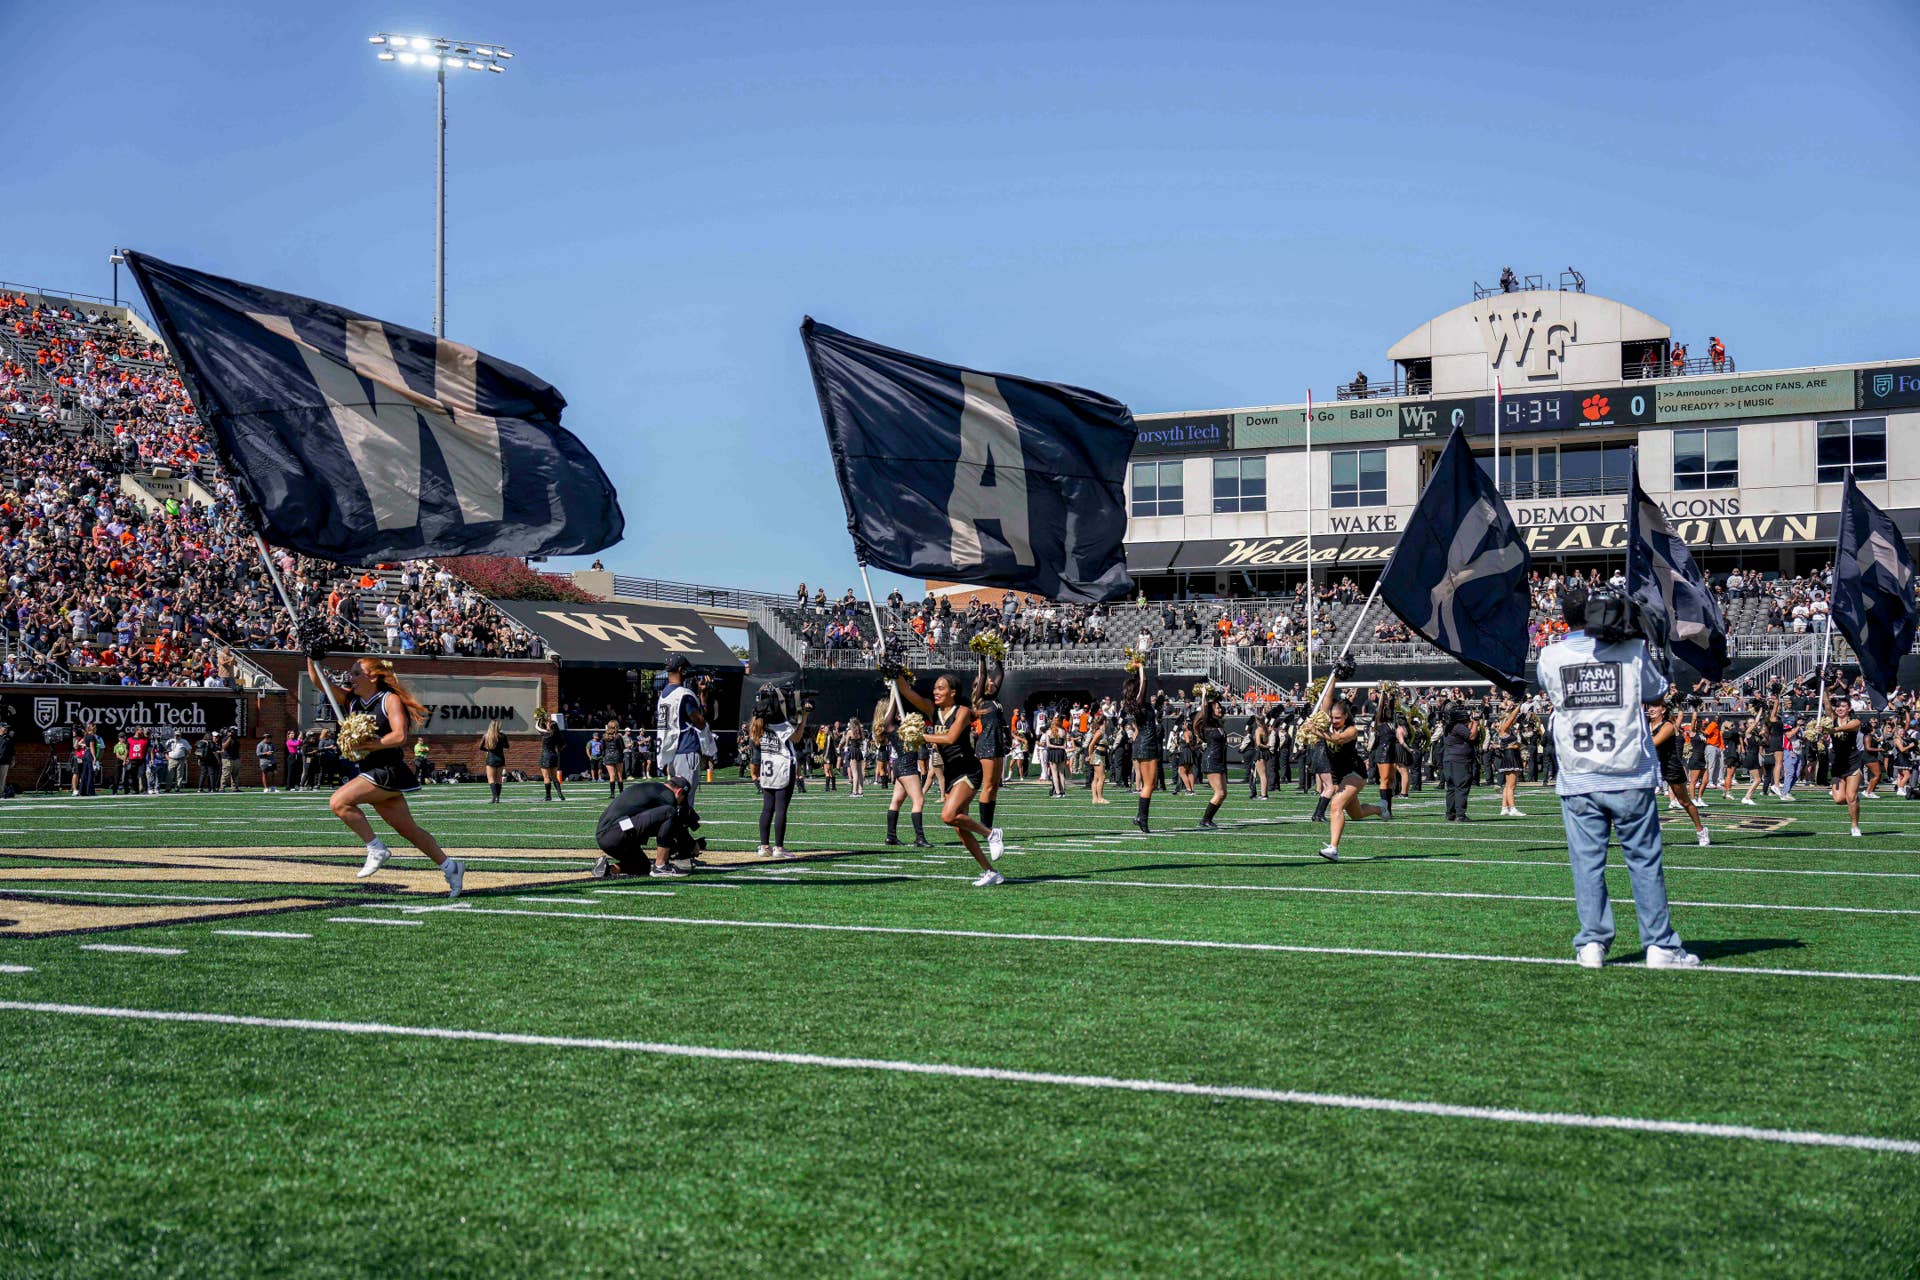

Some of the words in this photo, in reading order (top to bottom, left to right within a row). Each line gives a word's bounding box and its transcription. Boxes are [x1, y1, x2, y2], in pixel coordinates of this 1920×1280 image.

[1474, 306, 1578, 381] WF
[1676, 387, 1729, 398] Announcer:
[1730, 383, 1773, 394] DEACON
[1775, 380, 1805, 391] FANS,
[1806, 379, 1828, 388] ARE
[1349, 408, 1374, 420] Ball
[1376, 407, 1393, 419] On
[1505, 398, 1560, 424] 4:34
[1630, 395, 1646, 416] 0
[1657, 403, 1679, 413] YOU
[1680, 401, 1719, 412] READY?
[1743, 397, 1774, 408] MUSIC
[246, 312, 503, 530] W
[1246, 415, 1278, 427] Down
[1318, 411, 1335, 422] Go
[1400, 405, 1437, 432] WF
[1138, 425, 1185, 443] orsyth
[1184, 423, 1220, 440] Tech
[948, 371, 1035, 567] A
[147, 481, 174, 490] ECTION
[1330, 514, 1397, 533] WAKE
[1517, 503, 1605, 525] DEMON
[1216, 538, 1396, 566] Welcome
[1526, 514, 1818, 551] EACOWN
[536, 611, 704, 652] WF
[1579, 668, 1615, 681] FARM
[1566, 680, 1616, 694] BUREAU
[1574, 694, 1617, 704] INSURANCE
[64, 701, 152, 731] Forsyth
[154, 702, 206, 725] Tech
[440, 704, 514, 720] STADIUM
[1572, 721, 1616, 752] 83
